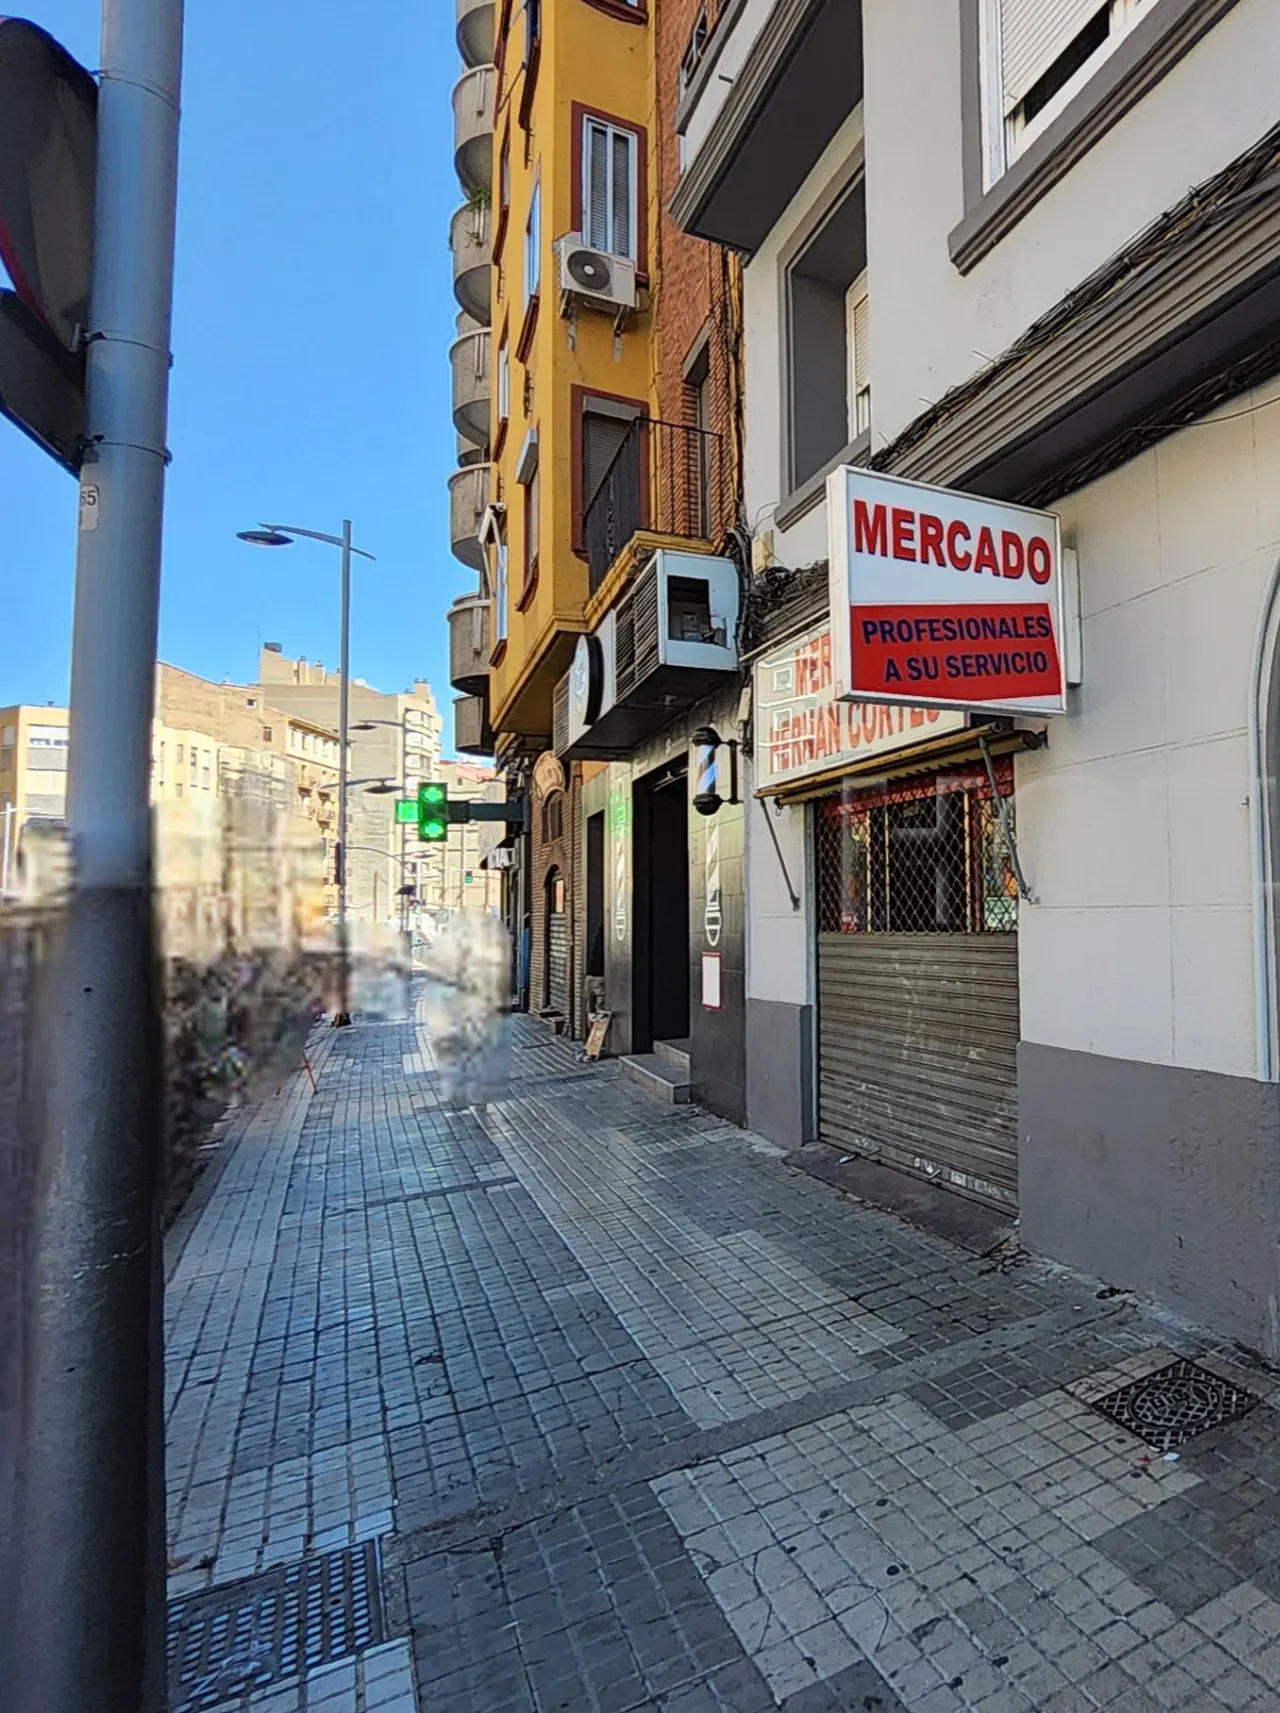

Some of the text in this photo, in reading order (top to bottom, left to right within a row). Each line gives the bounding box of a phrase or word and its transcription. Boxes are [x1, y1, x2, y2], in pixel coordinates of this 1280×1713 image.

[853, 499, 1052, 586] MERCADO
[862, 616, 1051, 646] PROFESIONALES
[884, 651, 1049, 683] A SU SERVICIO
[769, 702, 941, 775] HERNAN COR
